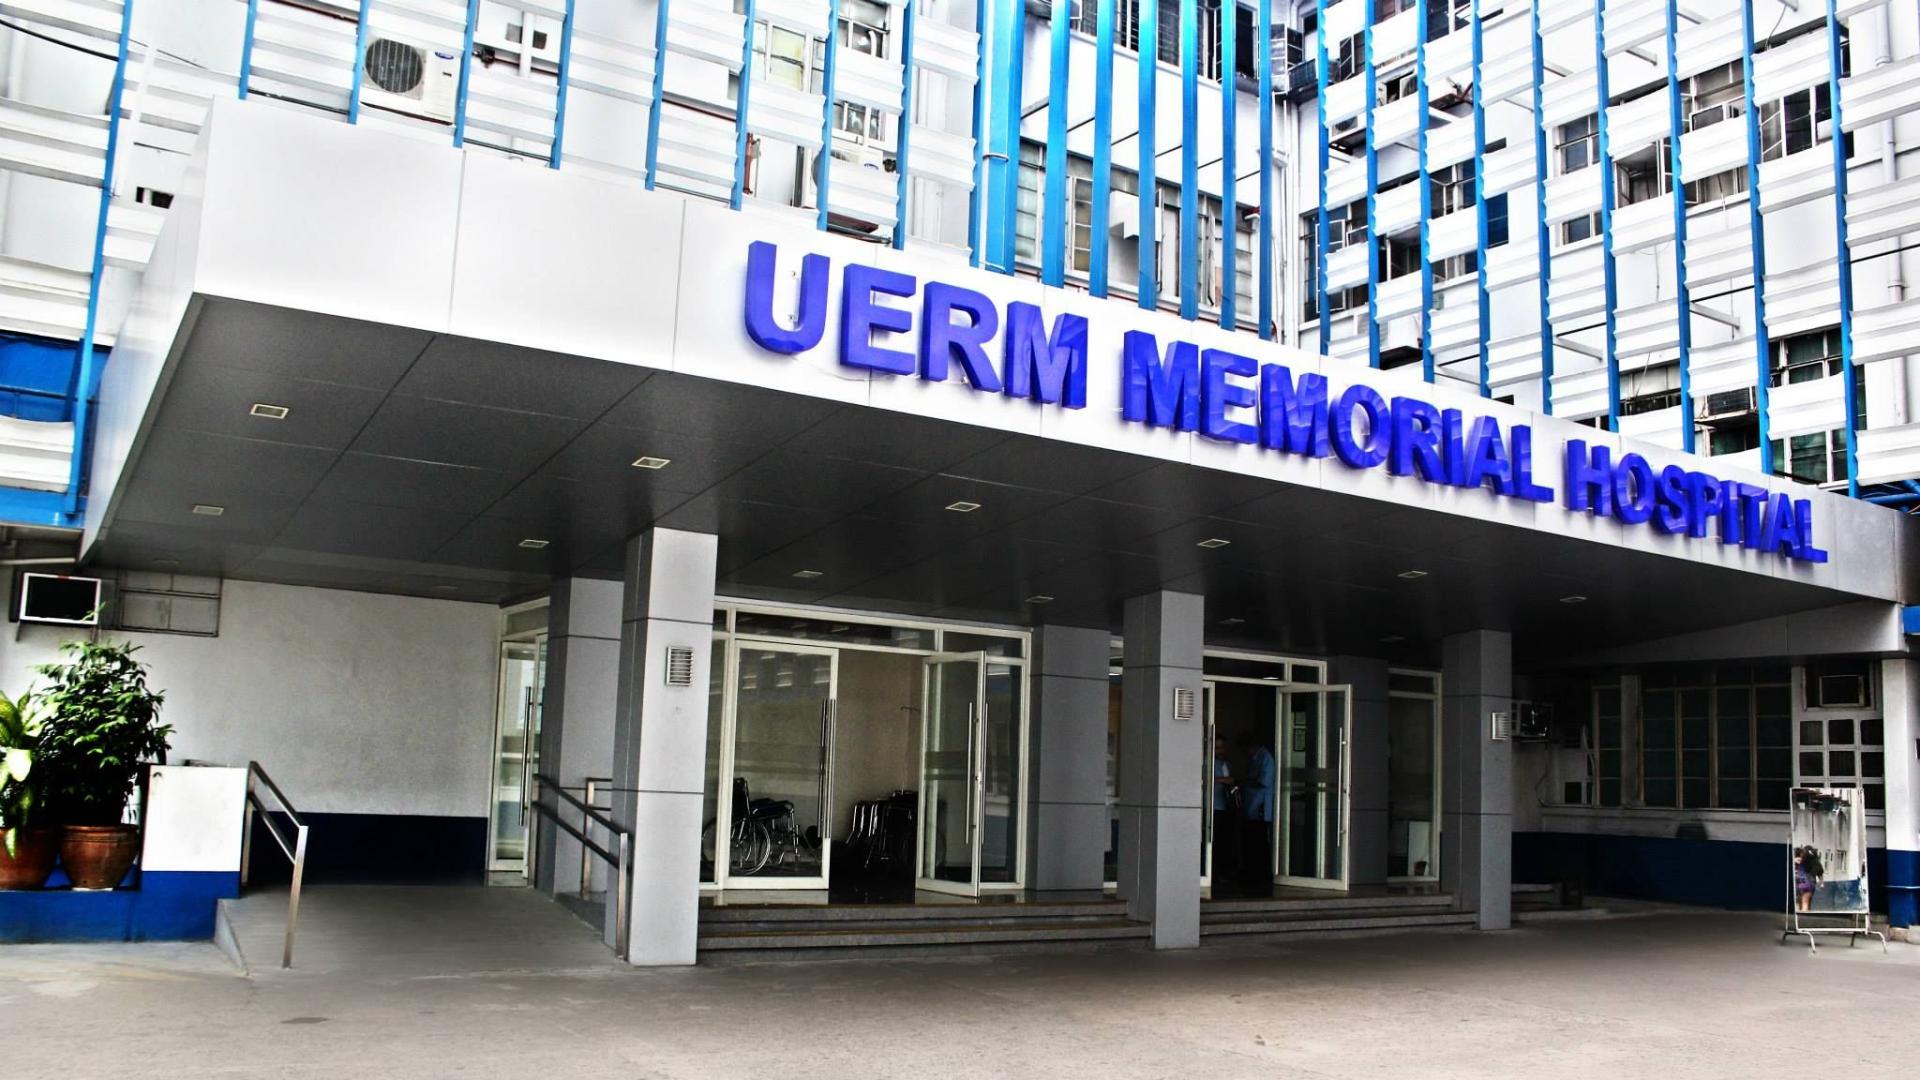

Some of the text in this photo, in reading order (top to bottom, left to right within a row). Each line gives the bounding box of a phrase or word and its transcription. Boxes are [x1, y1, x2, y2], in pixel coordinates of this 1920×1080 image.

[744, 240, 1829, 564] UERM MEMORIAL HOSPITAL
